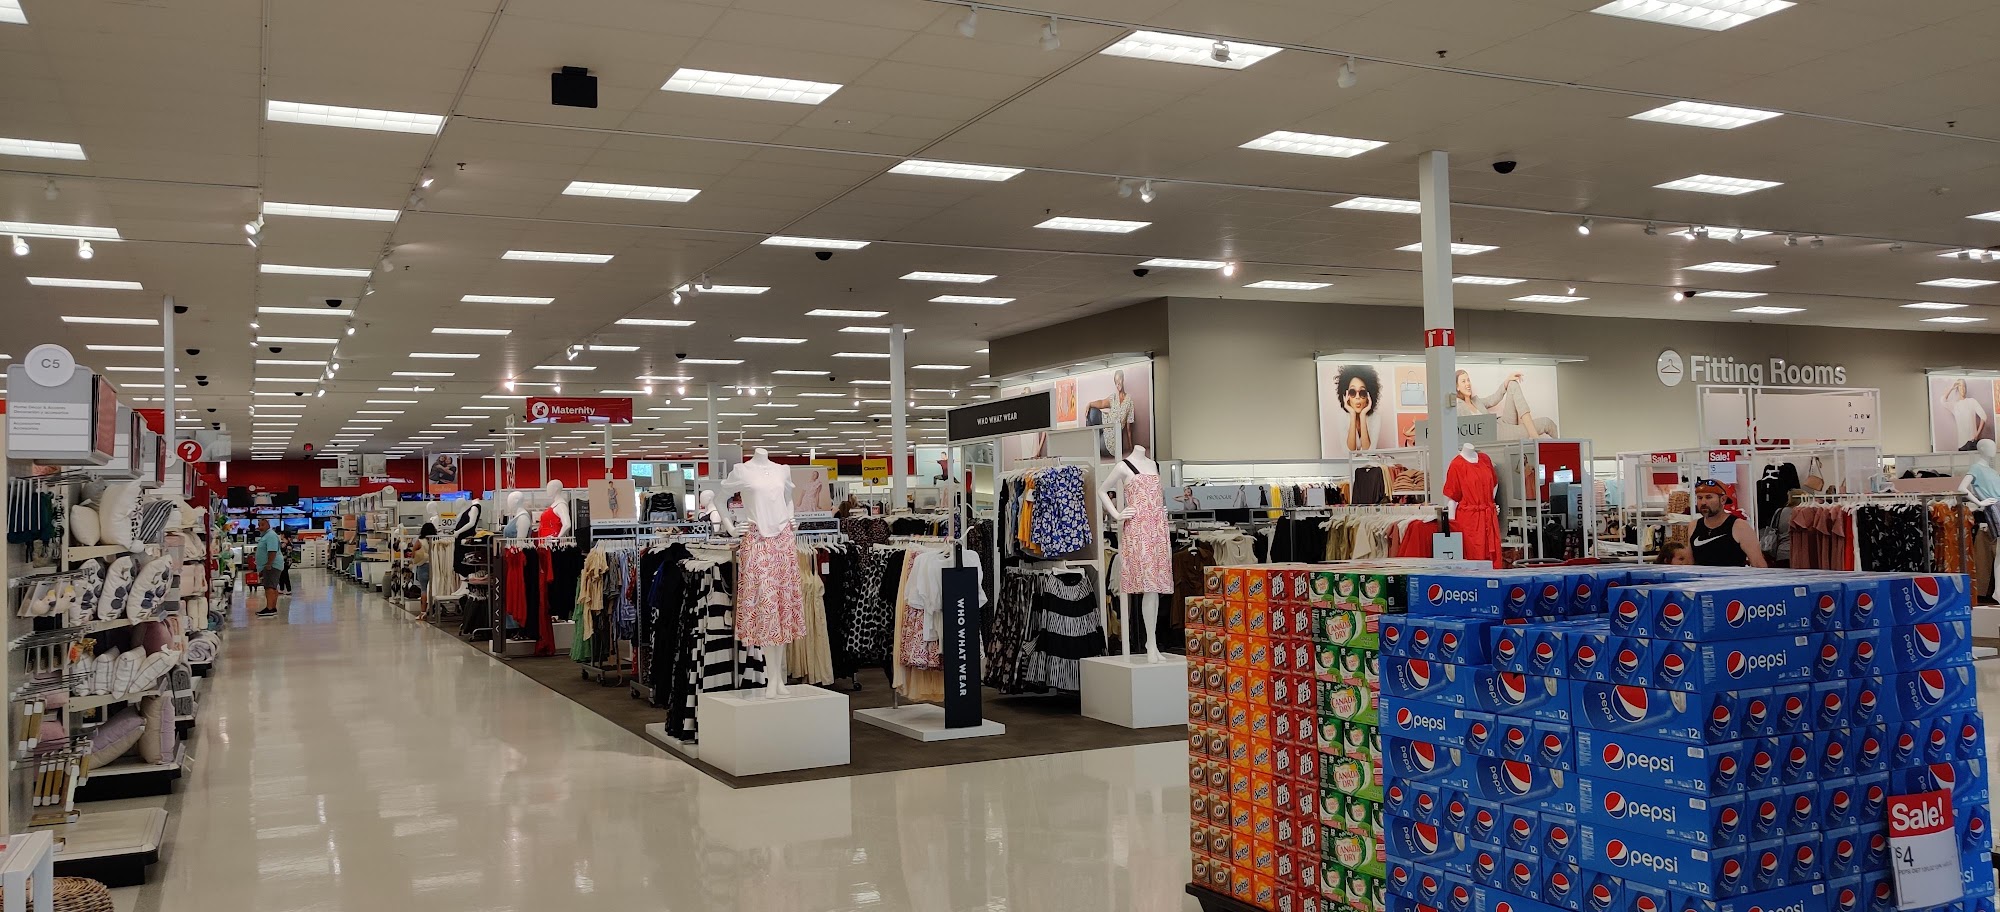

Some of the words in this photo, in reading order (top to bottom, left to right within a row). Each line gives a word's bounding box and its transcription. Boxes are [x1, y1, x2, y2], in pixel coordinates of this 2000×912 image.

[41, 359, 60, 369] C5
[1690, 355, 1764, 386] Fitting
[1770, 358, 1847, 385] Rooms
[551, 406, 595, 415] Maternity
[977, 417, 989, 426] WHO
[989, 415, 1002, 424] WHAT
[1003, 412, 1017, 421] WEAR
[1848, 426, 1865, 434] day
[1651, 455, 1671, 463] Sale!
[1709, 451, 1730, 462] Sale!
[1445, 589, 1477, 604] pepsi
[1902, 586, 1916, 616] pepsi
[957, 597, 966, 626] WHO
[1748, 600, 1787, 622] pepsi
[957, 628, 967, 661] WHAT
[1903, 634, 1917, 663] pepsi
[1749, 650, 1787, 673] pepsi
[958, 664, 967, 697] WEAR
[1396, 665, 1408, 691] pepsi
[1486, 678, 1501, 706] pepsi
[1908, 681, 1921, 710] pepsi
[1599, 692, 1616, 723] pepsi
[1414, 717, 1445, 731] pepsi
[1400, 746, 1414, 773] pepsi
[1627, 752, 1674, 773] pepsi
[1489, 765, 1505, 795] pepsi
[1629, 801, 1676, 823] pepsi
[1891, 797, 1945, 831] Sale!
[1402, 826, 1416, 854] pepsi
[1631, 850, 1678, 873] pepsi
